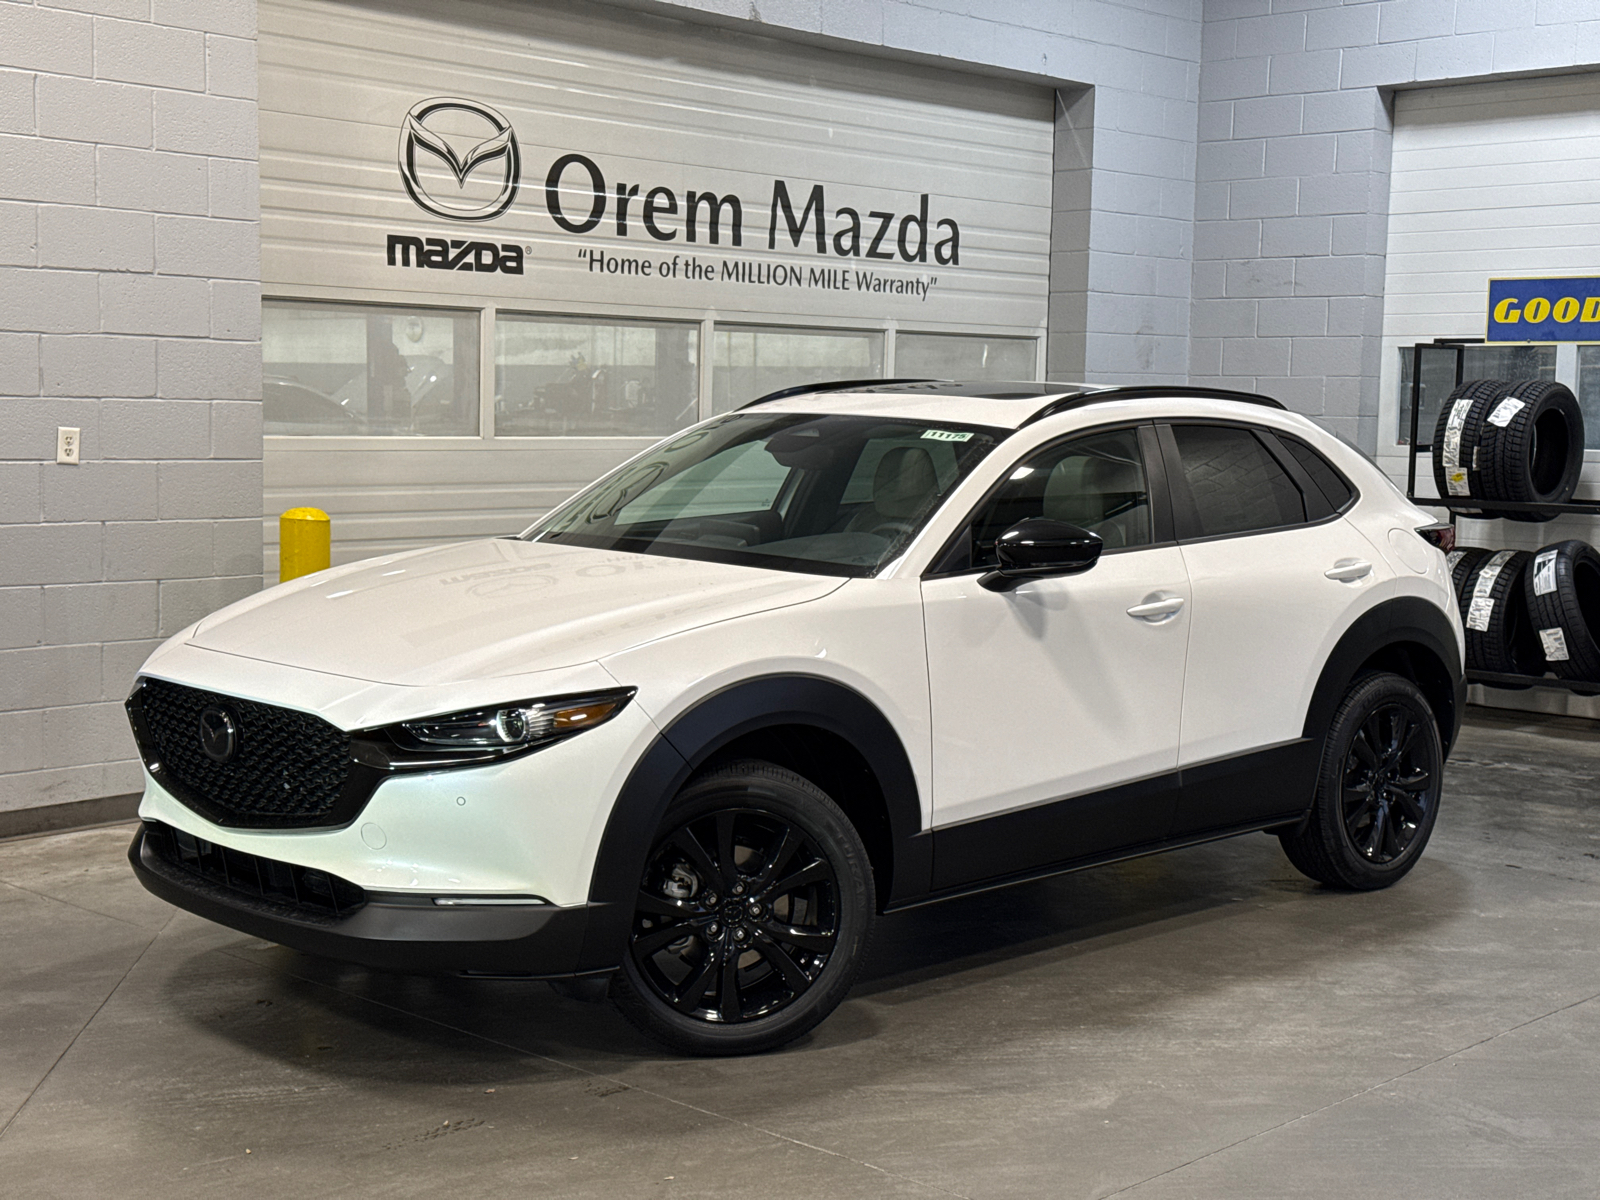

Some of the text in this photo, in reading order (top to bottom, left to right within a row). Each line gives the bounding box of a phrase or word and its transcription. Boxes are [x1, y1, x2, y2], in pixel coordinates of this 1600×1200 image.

[545, 153, 961, 266] Orem Mazda
[658, 255, 680, 278] of
[684, 256, 715, 281] the
[720, 260, 802, 287] MILLION
[807, 267, 850, 291] MILE
[1493, 296, 1600, 324] GOOD
[930, 431, 968, 440] 11175
